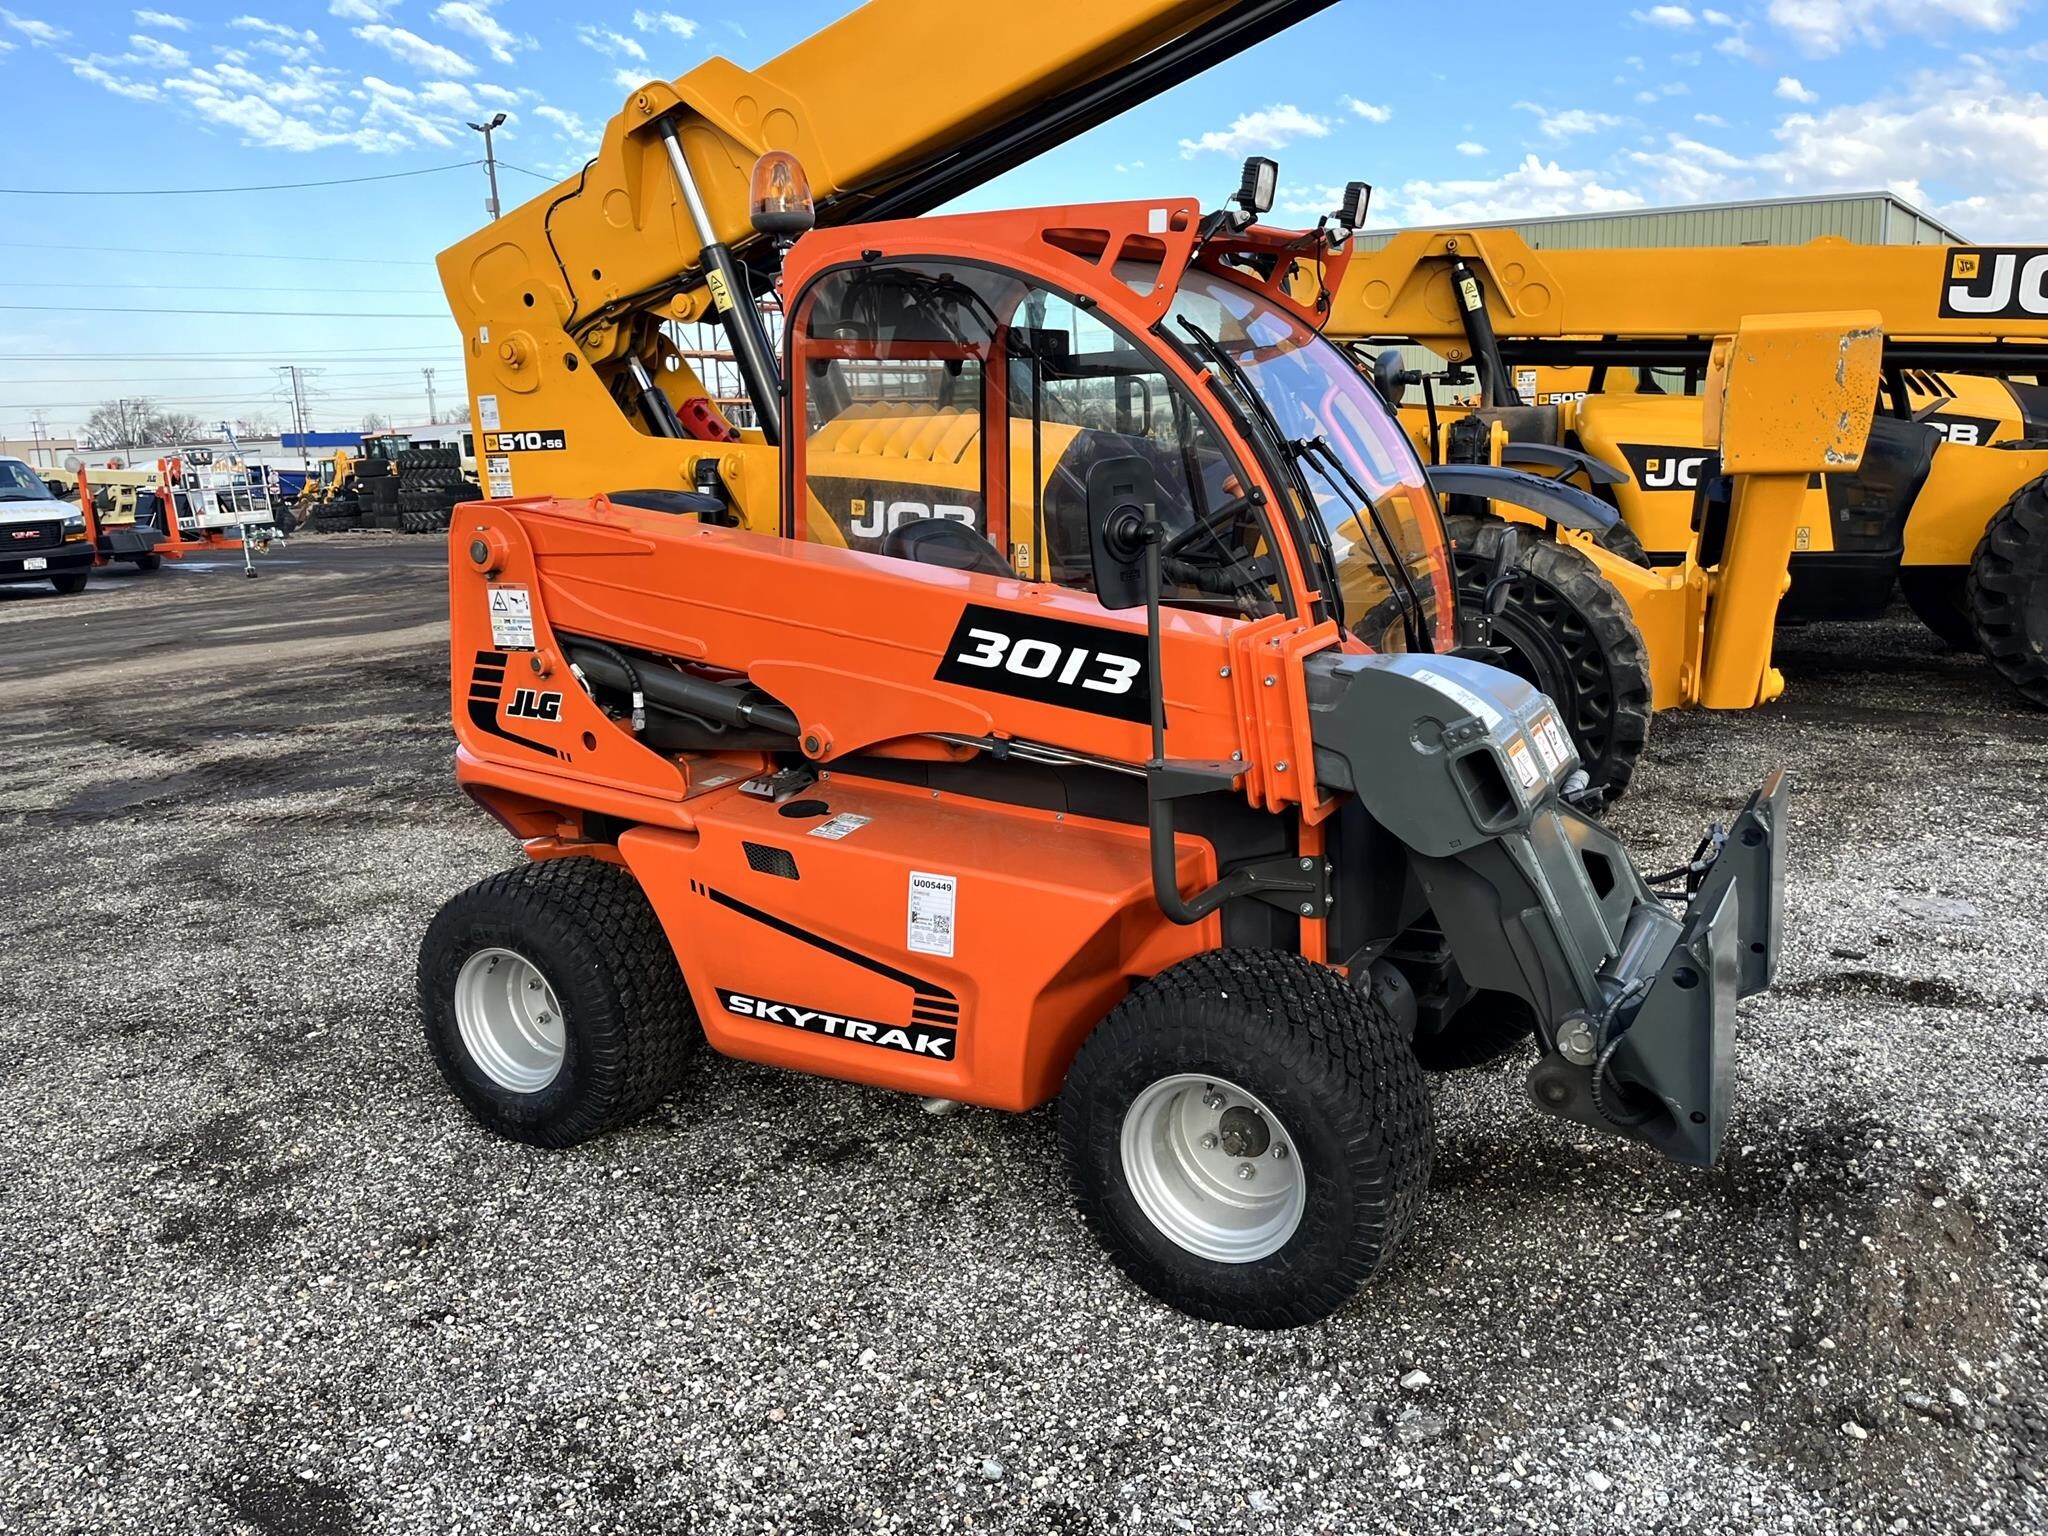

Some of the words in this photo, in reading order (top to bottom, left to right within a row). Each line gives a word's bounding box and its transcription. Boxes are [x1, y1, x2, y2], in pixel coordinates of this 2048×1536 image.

[498, 432, 563, 451] 510-56
[11, 530, 41, 540] GMC
[957, 627, 1142, 694] 3013
[506, 688, 563, 721] JLG
[913, 879, 952, 892] U005449
[728, 994, 952, 1058] SKYTRAK
